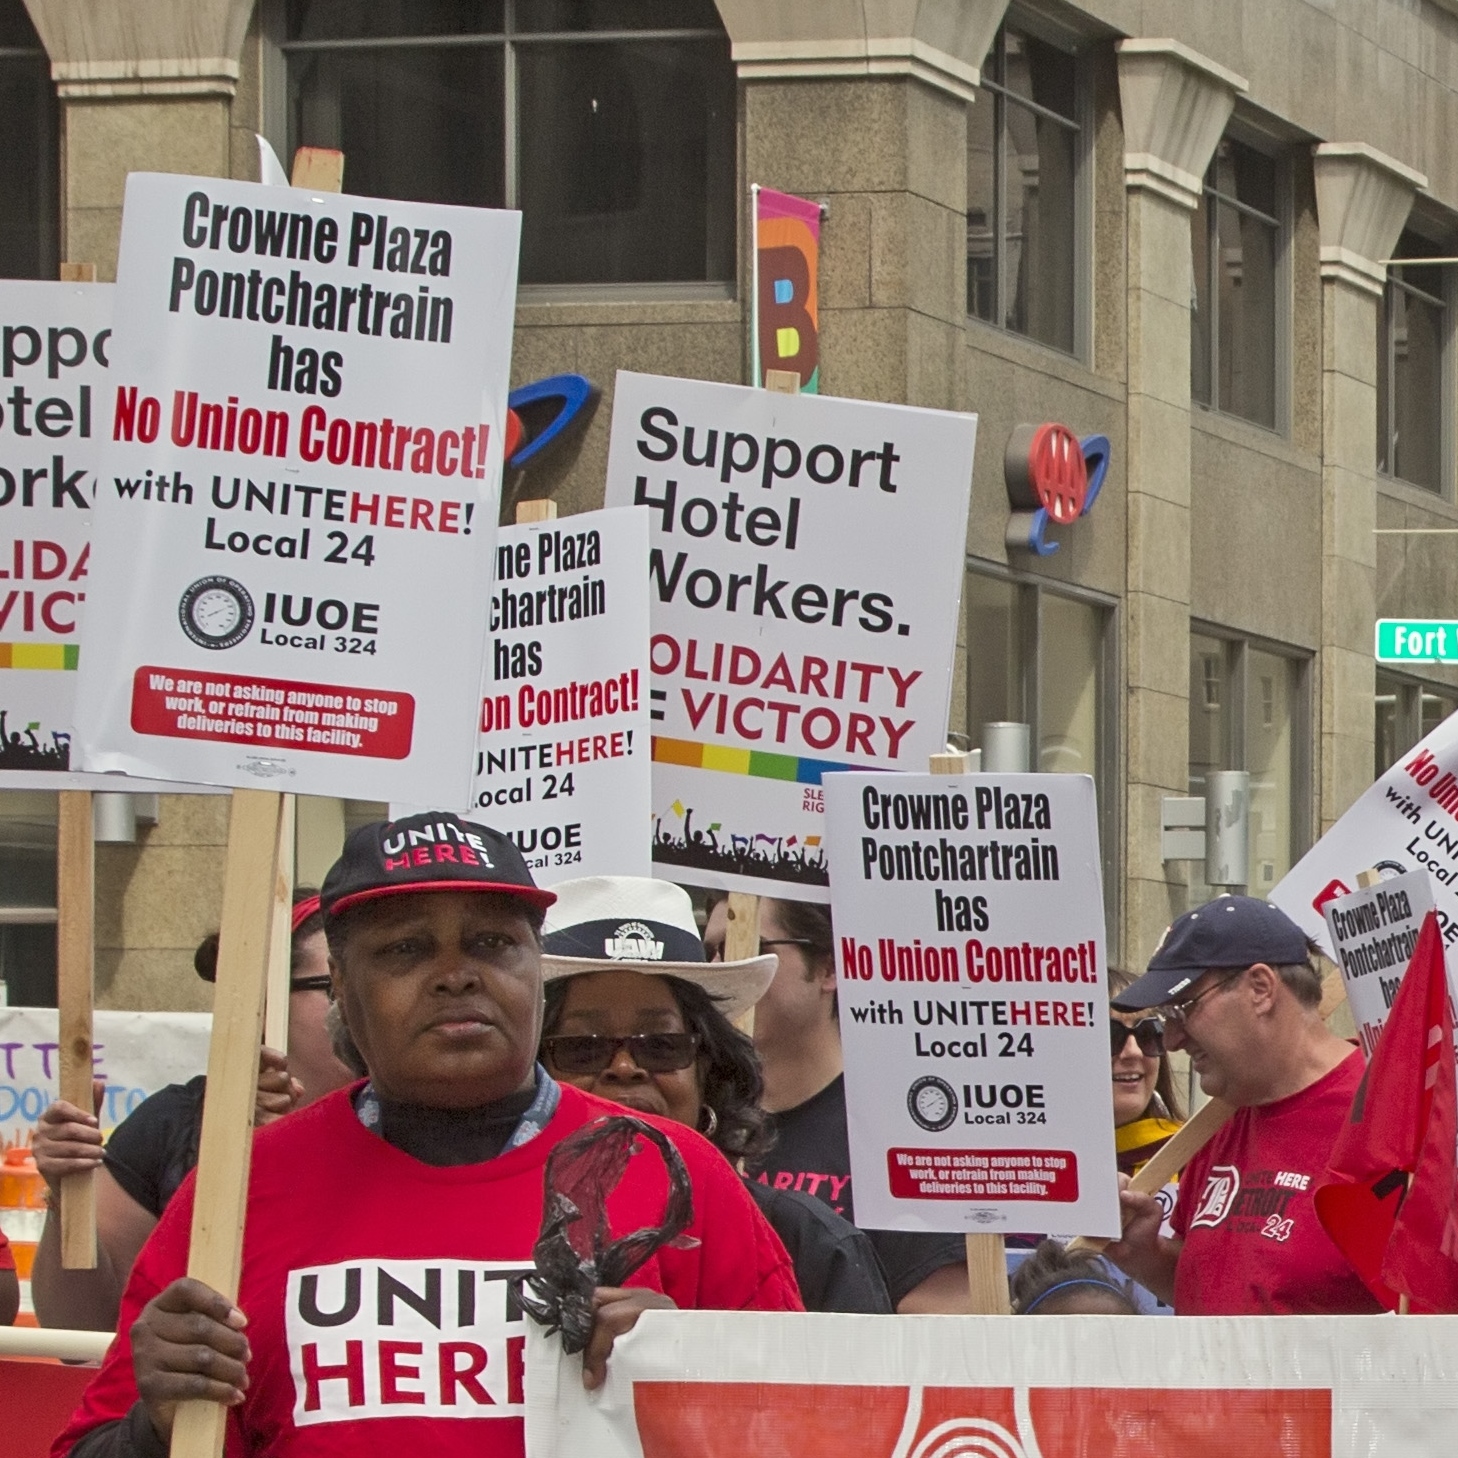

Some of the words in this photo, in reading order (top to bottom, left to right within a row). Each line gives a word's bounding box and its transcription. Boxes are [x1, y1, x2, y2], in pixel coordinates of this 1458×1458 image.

[182, 192, 338, 263] Crowne
[348, 212, 452, 277] Plaza
[169, 256, 454, 343] Pontchartrain
[267, 334, 343, 397] has
[113, 385, 161, 444] No
[170, 390, 289, 458] Union
[299, 404, 490, 480] Contract!
[636, 406, 900, 494] Support
[114, 470, 194, 505] with
[210, 476, 475, 534] UNITEHERE!
[633, 476, 800, 550] Hotel
[204, 518, 310, 560] Local
[324, 530, 376, 567] 24
[538, 529, 600, 575] Plaza
[263, 592, 380, 635] IUOE
[648, 548, 910, 636] Workers.
[260, 628, 325, 651] Local
[334, 636, 377, 655] 324
[1395, 626, 1446, 656] Fort
[650, 633, 923, 710] OLIDARITY
[518, 668, 639, 729] Contract!
[682, 688, 916, 759] VICTORY
[863, 786, 968, 830] Crowne
[976, 786, 1051, 830] Plaza
[383, 822, 484, 854] UNITE
[385, 844, 494, 871] HERE!
[862, 836, 1059, 881] Pontchartrain
[935, 888, 989, 932] has
[1332, 899, 1380, 942] Crowne
[1376, 888, 1412, 923] Plaza
[842, 938, 872, 980] No
[878, 938, 958, 982] Union
[966, 939, 1098, 983] Contract!
[850, 1001, 902, 1024] with
[914, 1000, 1095, 1028] UNITEHERE!
[915, 1032, 988, 1058] Local
[998, 1033, 1034, 1058] 24
[963, 1084, 1046, 1109] IUOE
[964, 1111, 1012, 1126] Local
[1016, 1112, 1047, 1126] 324
[1274, 1171, 1310, 1190] HERE
[1261, 1214, 1294, 1241] 24
